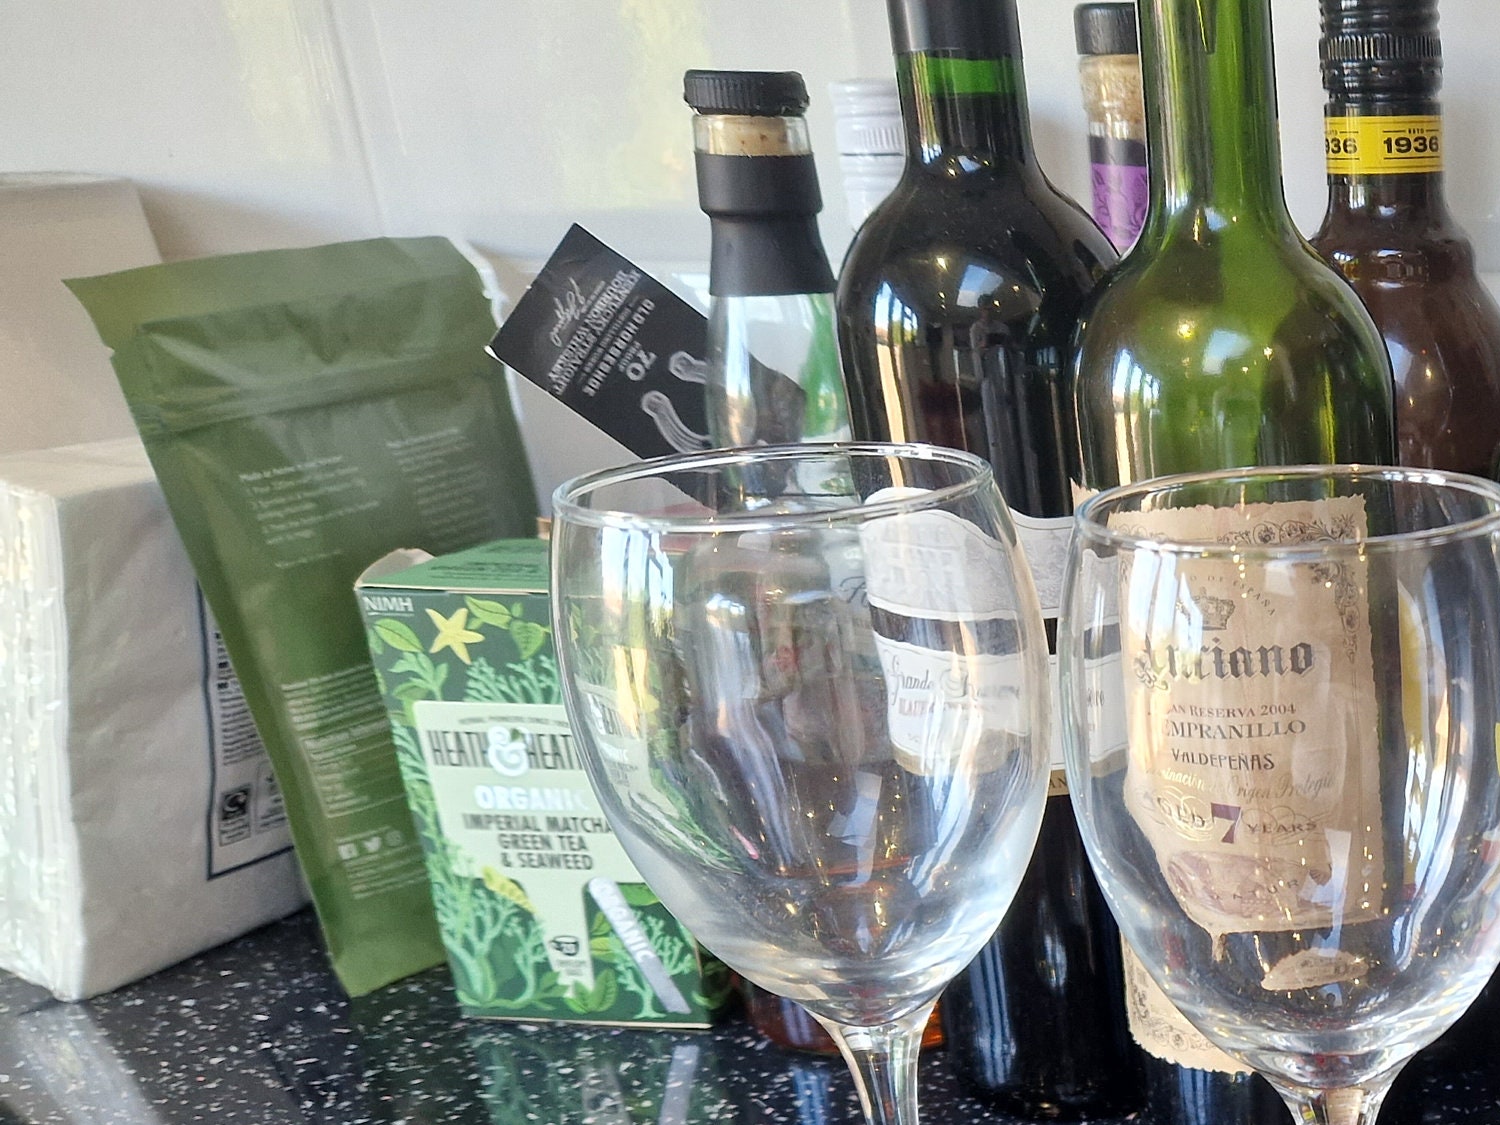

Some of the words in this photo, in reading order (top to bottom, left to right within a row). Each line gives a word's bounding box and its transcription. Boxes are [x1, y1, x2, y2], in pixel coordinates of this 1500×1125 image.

[1383, 135, 1439, 154] 1936
[583, 269, 629, 328] BOURBON
[591, 268, 643, 336] KENTUCKY
[631, 297, 656, 325] OLD
[545, 323, 591, 383] WHISKEY
[550, 331, 600, 396] STRAIGHT
[581, 321, 641, 398] HORSESHOE
[623, 345, 659, 385] 70
[362, 597, 414, 613] NIMH
[1190, 704, 1255, 719] RESERVA
[1260, 702, 1297, 716] 2004
[1171, 747, 1276, 771] VALDEPEÑAS
[462, 813, 542, 833] IMPERIAL
[546, 816, 613, 835] MATCHA
[1210, 802, 1243, 844] 7
[498, 834, 550, 851] GREEN
[556, 835, 589, 851] TEA
[500, 853, 513, 868] &
[517, 854, 594, 870] SEAWEED
